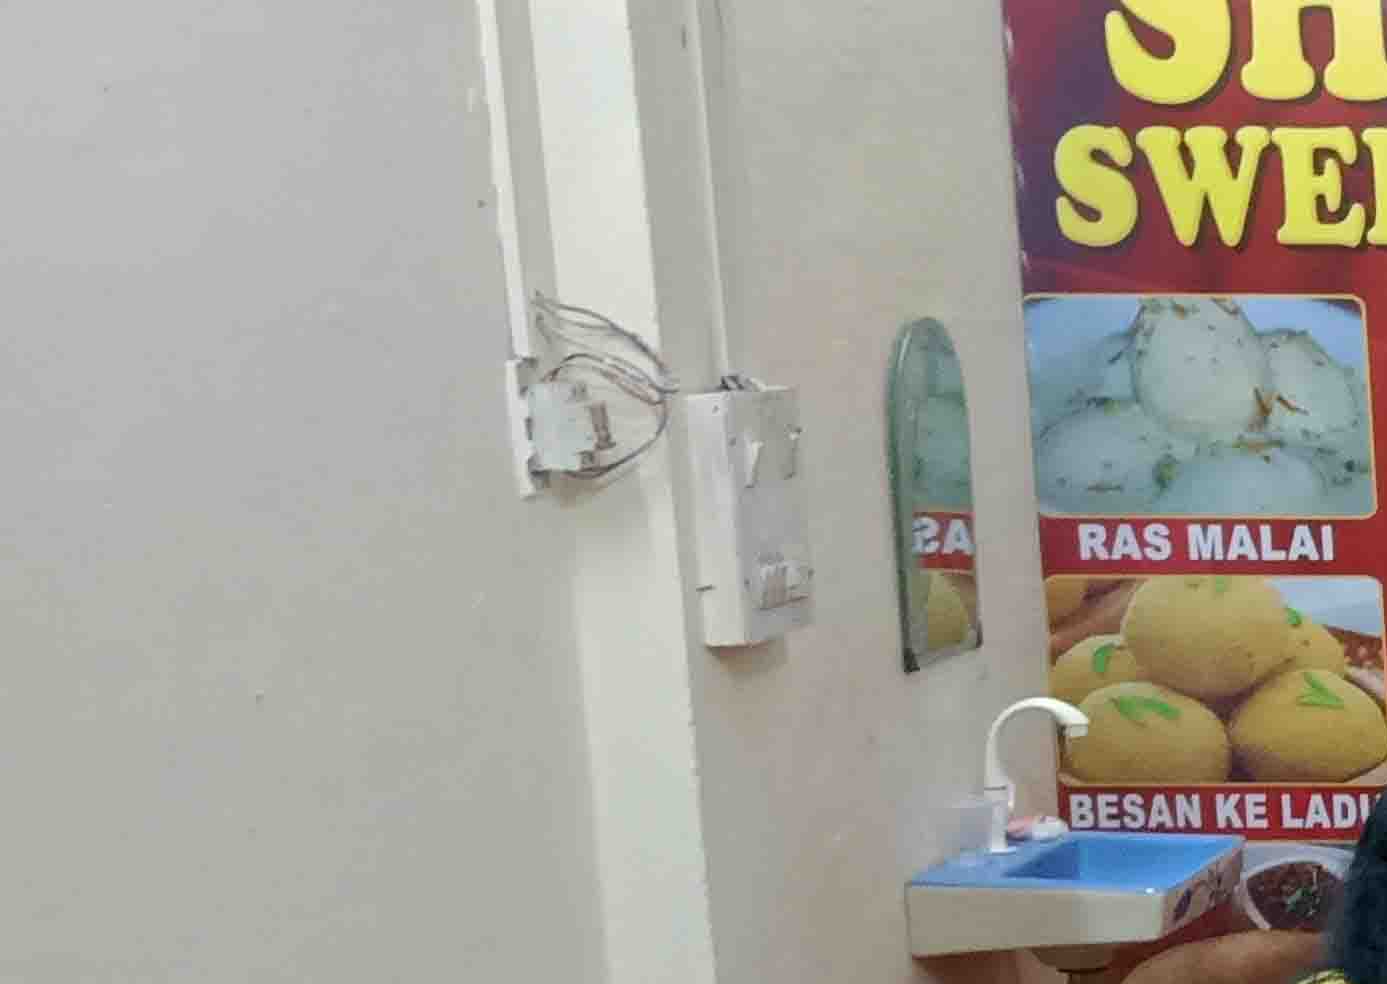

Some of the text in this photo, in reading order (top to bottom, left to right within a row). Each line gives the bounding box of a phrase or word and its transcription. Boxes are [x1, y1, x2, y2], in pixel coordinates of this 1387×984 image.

[1077, 523, 1335, 561] RAS MALAI
[1068, 793, 1203, 829] BESAN
[1215, 793, 1269, 829] KE
